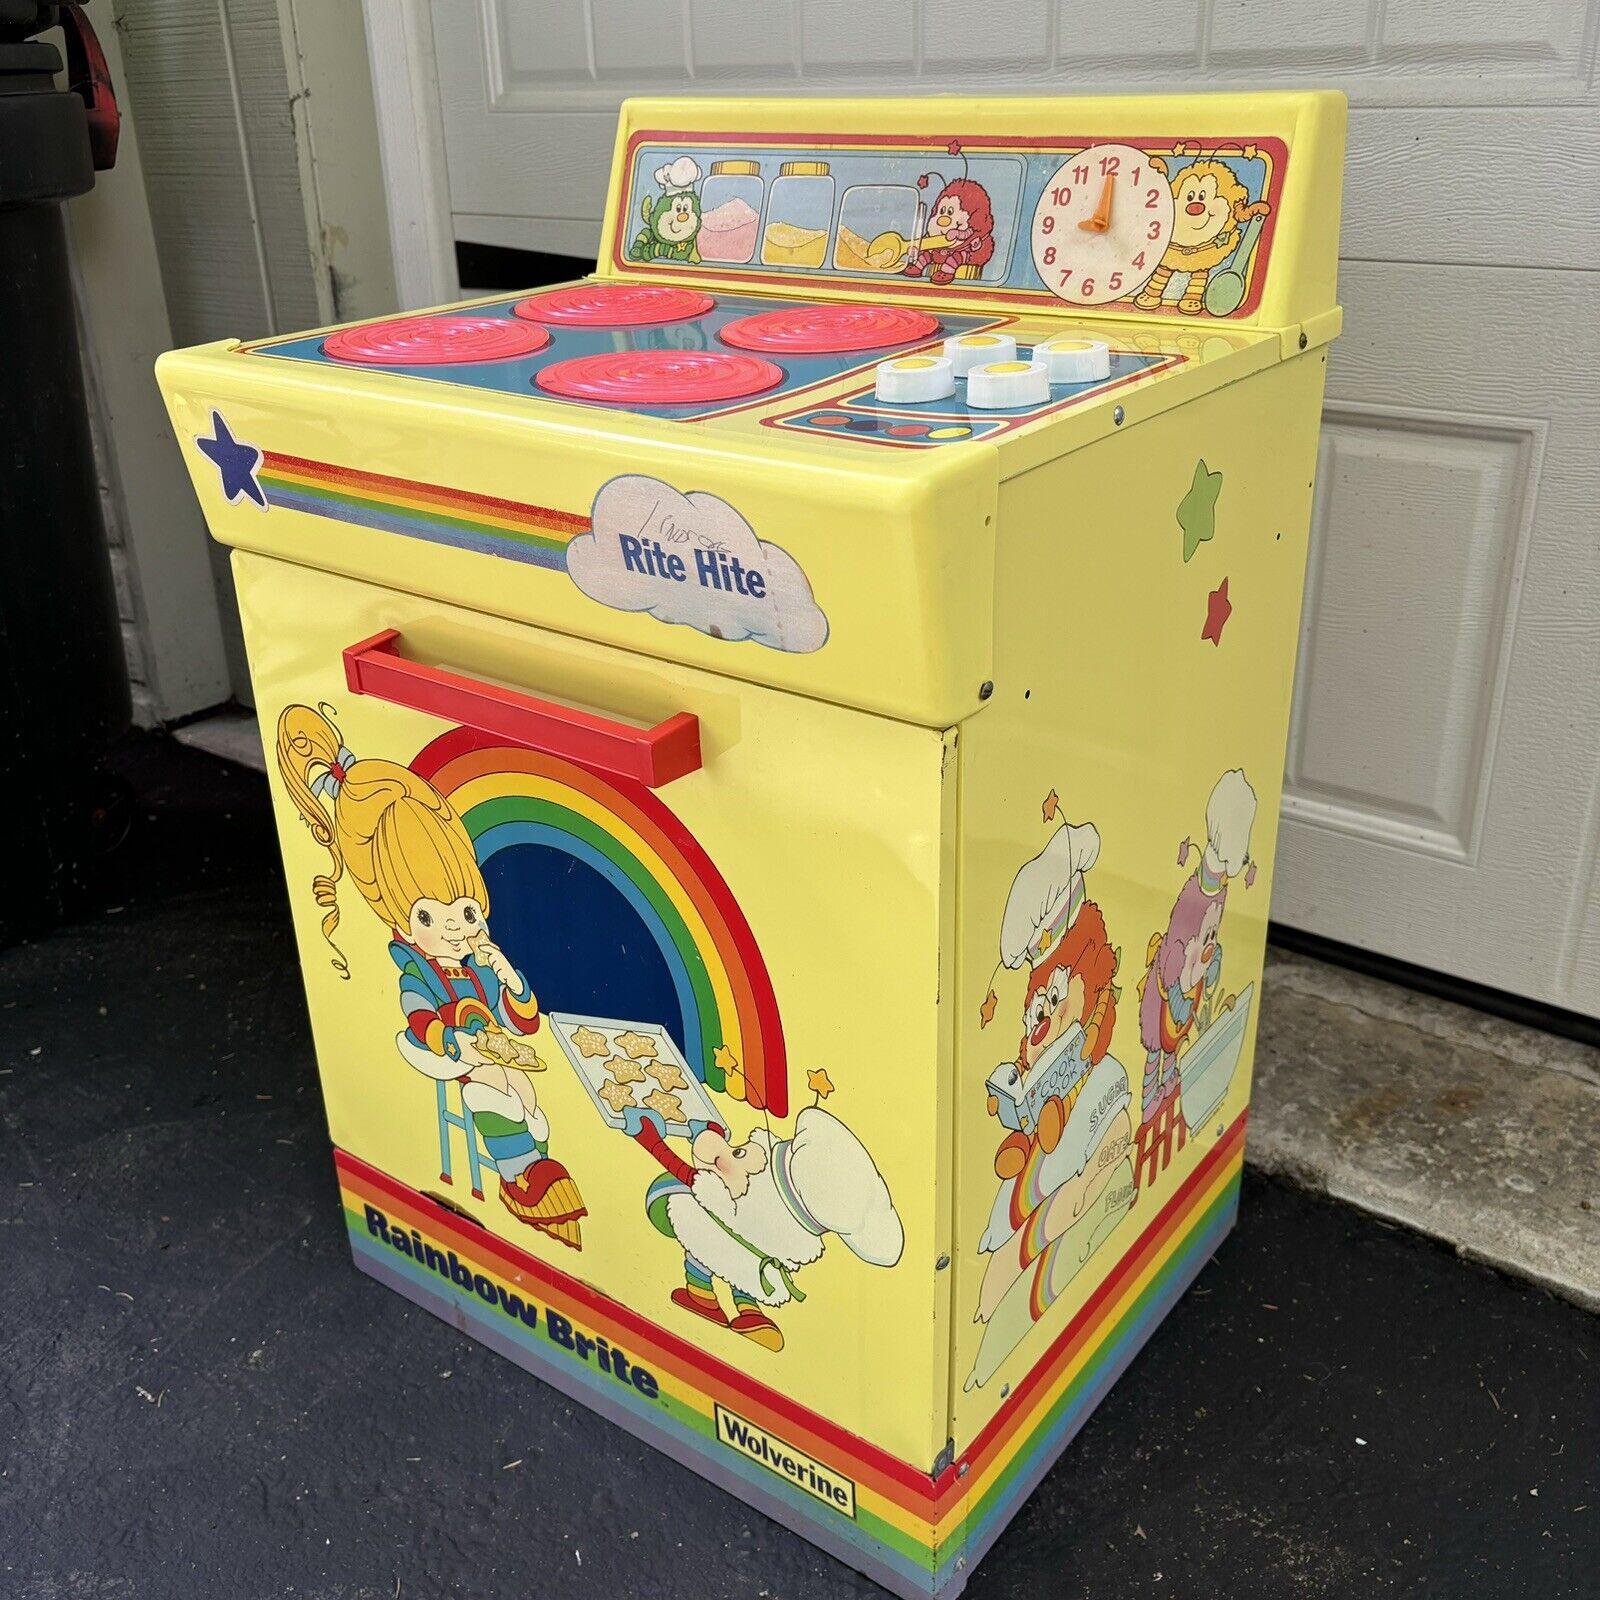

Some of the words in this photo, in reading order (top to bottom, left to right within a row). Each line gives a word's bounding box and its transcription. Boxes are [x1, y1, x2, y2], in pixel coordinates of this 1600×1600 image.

[1072, 165, 1089, 185] 11
[1099, 157, 1120, 176] 12
[1131, 167, 1141, 186] 1
[1051, 187, 1071, 206] 10
[1145, 189, 1160, 208] 2
[1042, 216, 1055, 234] 9
[1147, 221, 1161, 240] 3
[1043, 247, 1056, 265] 8
[1132, 251, 1145, 270] 4
[1059, 270, 1073, 287] 7
[1081, 278, 1094, 296] 6
[1109, 272, 1123, 290] 5
[619, 533, 686, 582] Rite
[694, 549, 766, 599] Hite
[1089, 1076, 1126, 1132] SUGAR
[364, 1203, 537, 1328] Rainbow
[546, 1308, 659, 1399] Brite
[723, 1414, 848, 1506] Wolverine
